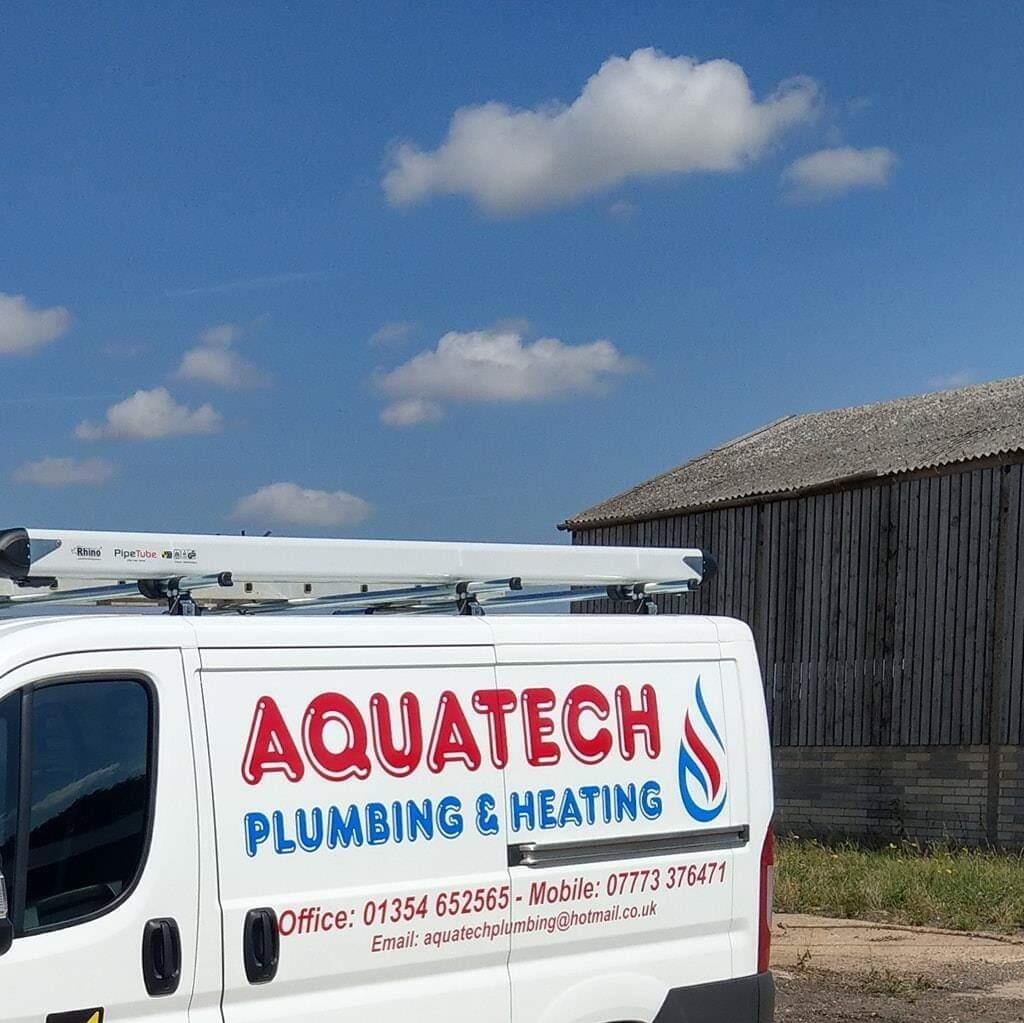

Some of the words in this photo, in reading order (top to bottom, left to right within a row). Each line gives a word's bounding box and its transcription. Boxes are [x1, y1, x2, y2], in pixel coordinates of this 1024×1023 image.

[77, 547, 101, 557] Rhino
[241, 683, 662, 786] AQUATECH
[244, 796, 464, 857] PLUMBING
[476, 793, 500, 836] &
[510, 780, 663, 832] HEATING
[278, 906, 356, 937] Office:
[363, 894, 428, 926] 01354
[435, 885, 510, 917] 652565
[528, 877, 601, 906] Mobile:
[606, 868, 661, 897] 07773
[665, 860, 727, 890] 376471
[371, 930, 419, 953] Email:
[423, 900, 658, 945] aquatechplumbing@hotmail.co.uk
